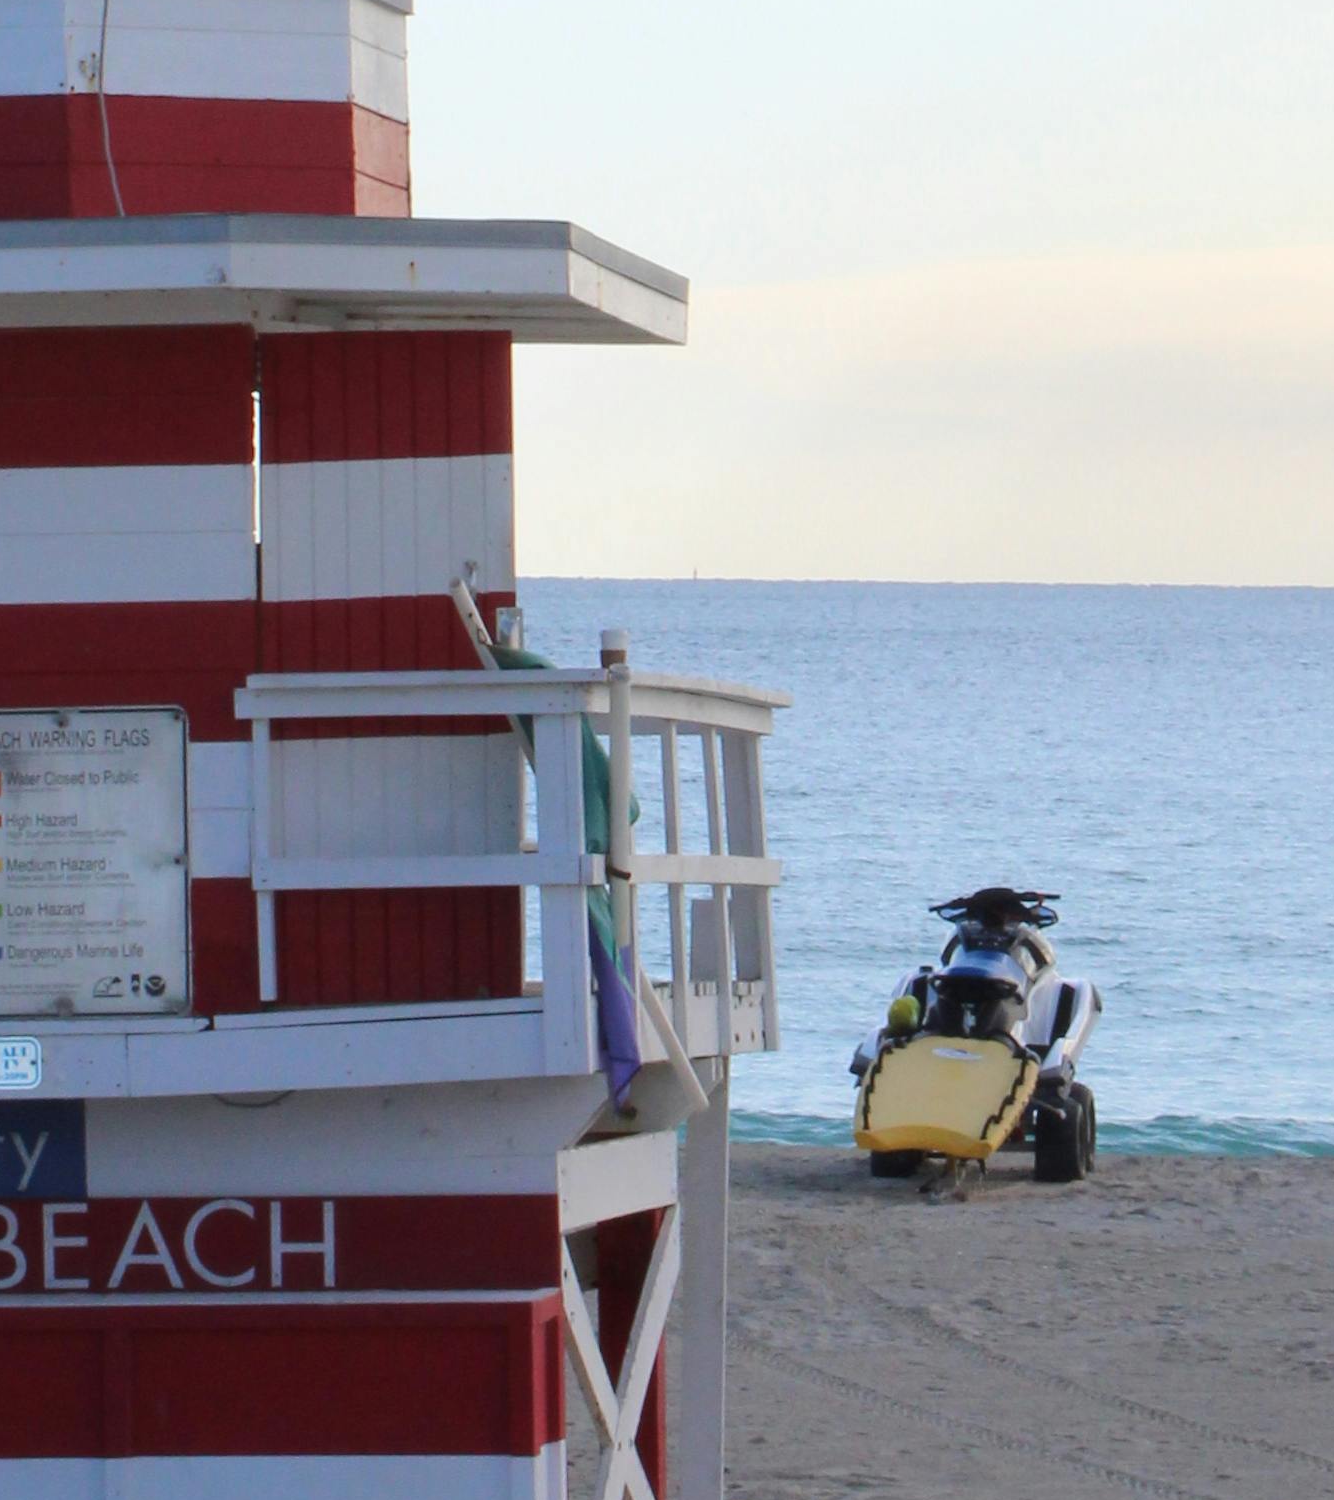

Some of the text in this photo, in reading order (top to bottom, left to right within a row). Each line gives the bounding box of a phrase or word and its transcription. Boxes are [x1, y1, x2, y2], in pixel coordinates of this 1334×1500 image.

[30, 730, 96, 748] WARNING
[104, 729, 151, 747] FLAGS
[7, 770, 139, 786] Water Closed to Public
[6, 813, 78, 830] High Hazard
[6, 857, 106, 872] Medium Hazard
[7, 902, 86, 917] Low Hazard
[8, 945, 73, 962] Dangerous
[122, 943, 144, 957] Life
